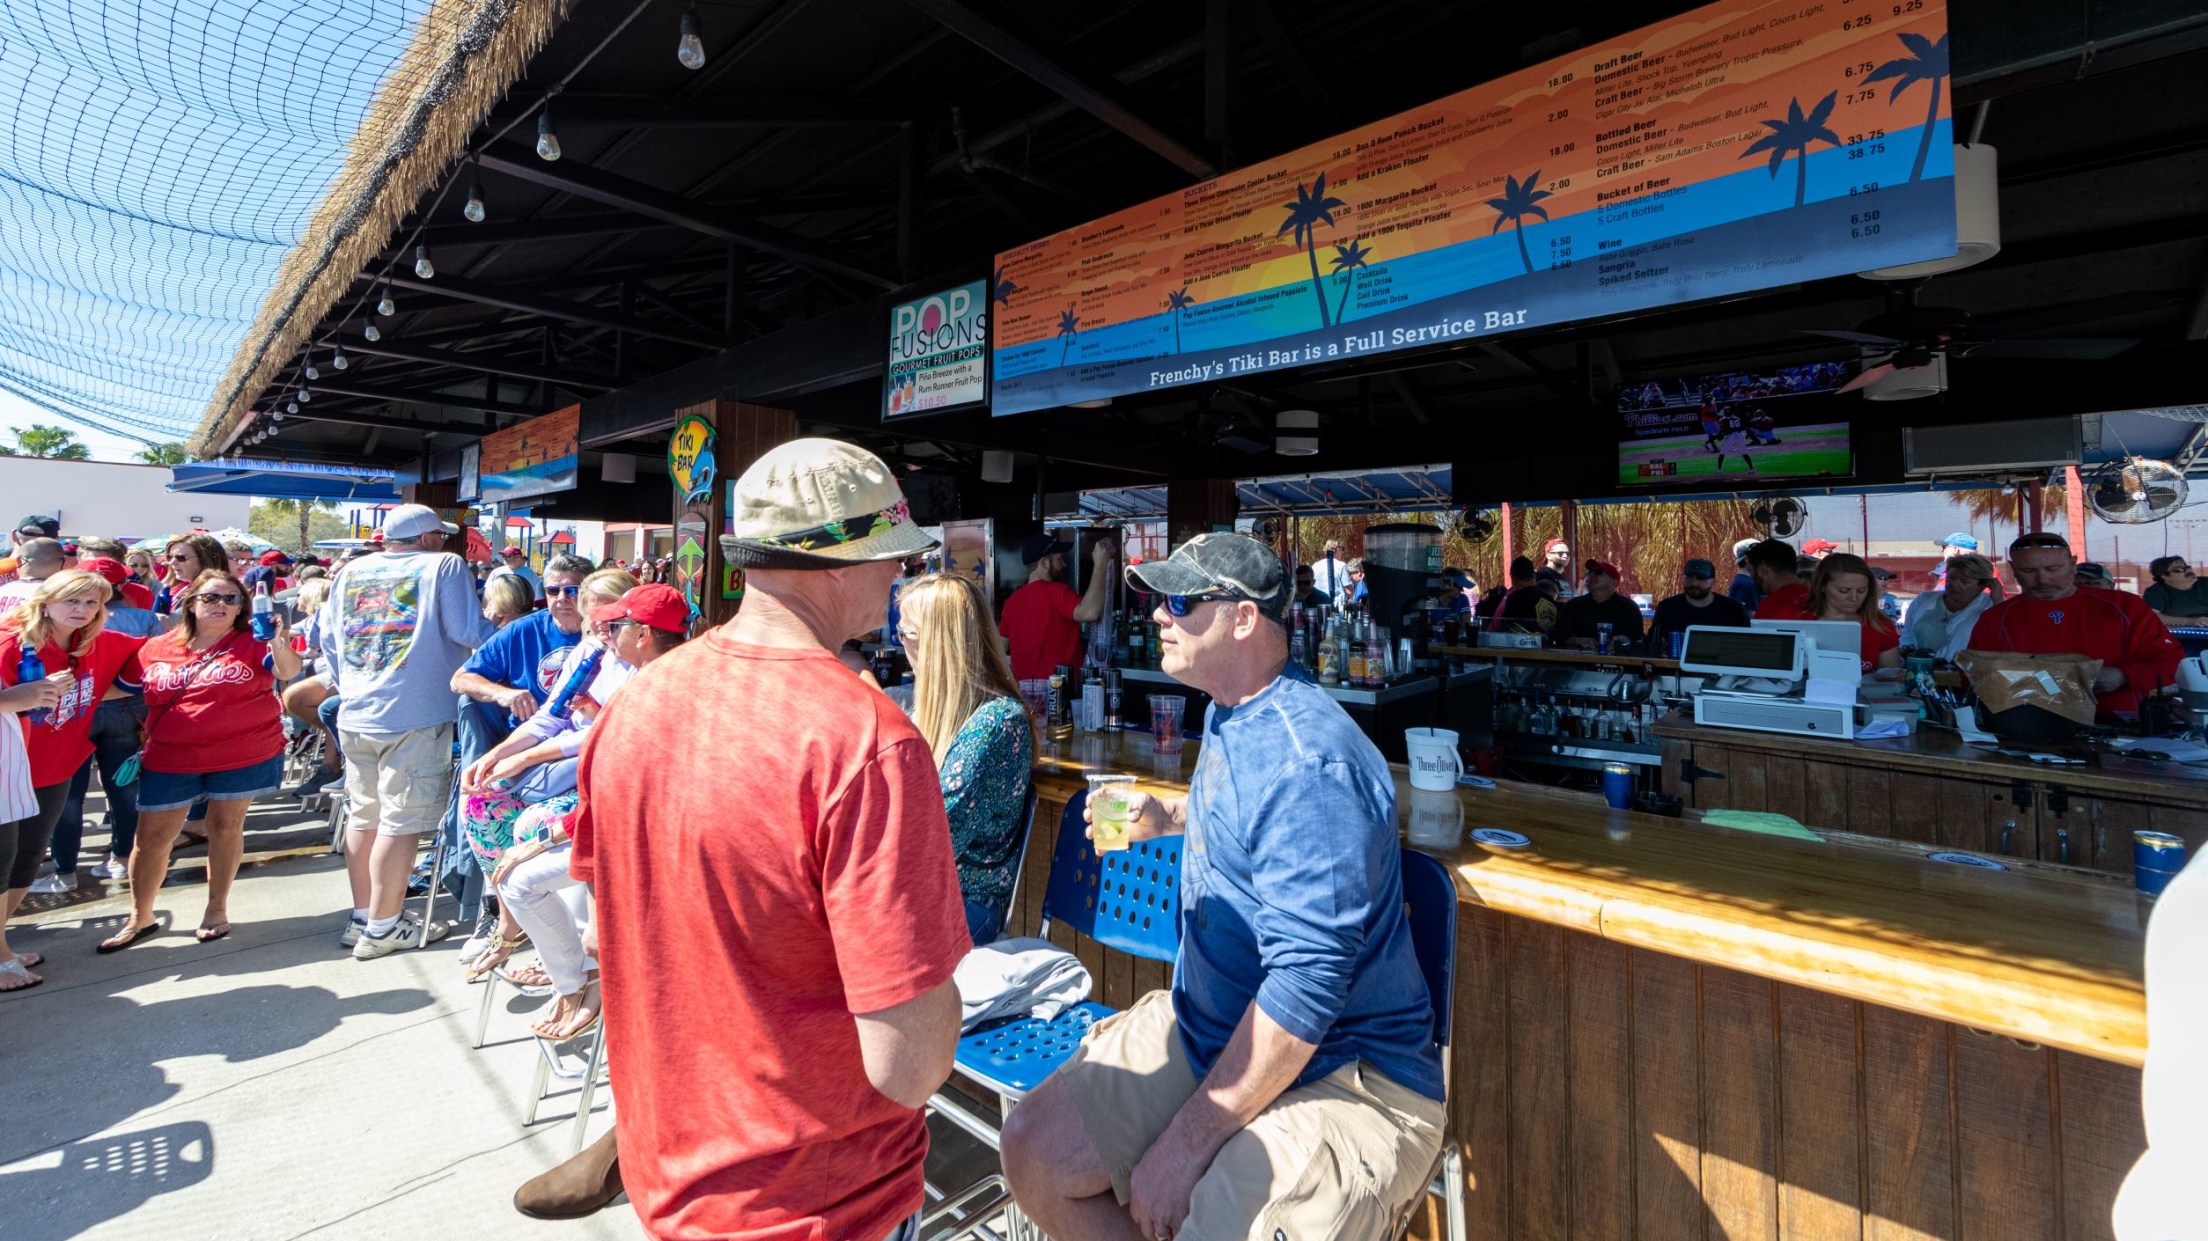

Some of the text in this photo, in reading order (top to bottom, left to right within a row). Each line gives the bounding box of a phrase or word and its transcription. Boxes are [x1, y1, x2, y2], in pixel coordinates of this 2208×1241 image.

[1893, 0, 1923, 15] 9.25
[1842, 14, 1871, 30] 6.25
[1594, 64, 1639, 84] Domestic
[1642, 55, 1665, 68] Beer
[1722, 30, 1740, 43] Bud
[1769, 13, 1796, 27] Coors
[1594, 50, 1642, 72] Draft Beer
[1845, 61, 1873, 77] 6.75
[1548, 72, 1572, 87] 18.00
[1595, 94, 1617, 107] Craft
[1620, 87, 1642, 99] Beer
[1652, 80, 1666, 90] Big
[1667, 72, 1693, 85] Storm
[1695, 60, 1730, 77] Brewery
[1732, 50, 1758, 64] Tropic
[1846, 89, 1874, 104] 7.75
[1548, 109, 1568, 122] 2.00
[1356, 116, 1443, 151] Don Q Rum Punch Bucket
[1595, 119, 1656, 142] Bottled Beer
[1596, 100, 1768, 153] Domestic Beer Budweiser, Bud Light,
[1847, 129, 1884, 146] 33.75
[1549, 142, 1574, 155] 18.00
[1596, 155, 1618, 166] Coors
[1644, 142, 1666, 152] Miller
[1668, 137, 1683, 146] Lite
[1596, 164, 1619, 177] Craft
[1622, 159, 1644, 170] Beer
[1654, 152, 1673, 162] Sam
[1674, 144, 1702, 157] Adams
[1705, 136, 1735, 149] Boston
[1848, 143, 1884, 159] 38.75
[1356, 170, 1371, 180] Add
[1376, 162, 1401, 174] Kraken
[1403, 154, 1429, 166] Floater
[1549, 178, 1569, 190] 2.00
[1597, 177, 1669, 201] Bucket of Beer
[1849, 182, 1879, 197] 6.50
[1356, 182, 1436, 210] 1800 Margarita Bucket
[1597, 185, 1687, 214] 5 Domestic Bottles
[1597, 204, 1664, 225] 5 Craft Bottles
[1850, 209, 1879, 224] 6.50
[1356, 231, 1372, 241] Add
[1377, 224, 1394, 234] 1800
[1396, 218, 1422, 230] Tequila
[1424, 211, 1451, 223] Floater
[1851, 224, 1880, 238] 6.50
[1550, 235, 1571, 247] 6.50
[1598, 239, 1622, 249] Wine
[1551, 247, 1571, 258] 7.50
[1356, 267, 1387, 280] Cocktails
[1598, 260, 1635, 273] Sangria
[1356, 276, 1392, 289] Well Drink
[1598, 266, 1669, 285] Spiked Seltzer
[1356, 286, 1390, 300] Call Drink
[1356, 293, 1408, 309] Premium Drink
[896, 289, 971, 353] POP
[891, 313, 986, 361] FUSIONS
[1150, 361, 1223, 385] Frenchy's
[1228, 352, 1265, 372] Tiki
[1268, 348, 1299, 365] Bar
[1305, 343, 1322, 359] is
[1344, 330, 1384, 352] Full
[1391, 318, 1476, 344] Service
[1483, 307, 1527, 329] Bar
[893, 346, 981, 375] GOURMET FRUIT POPS
[932, 367, 953, 380] Breeze
[954, 364, 967, 375] with
[918, 375, 983, 394] Rum Runner Fruit Pop
[919, 395, 947, 409] $10.50
[1624, 412, 1699, 428] Phillies.com
[678, 432, 694, 451] TIKI
[677, 454, 693, 471] BAR
[1049, 687, 1057, 715] TRULY
[1416, 756, 1436, 772] Three
[395, 929, 413, 940] N
